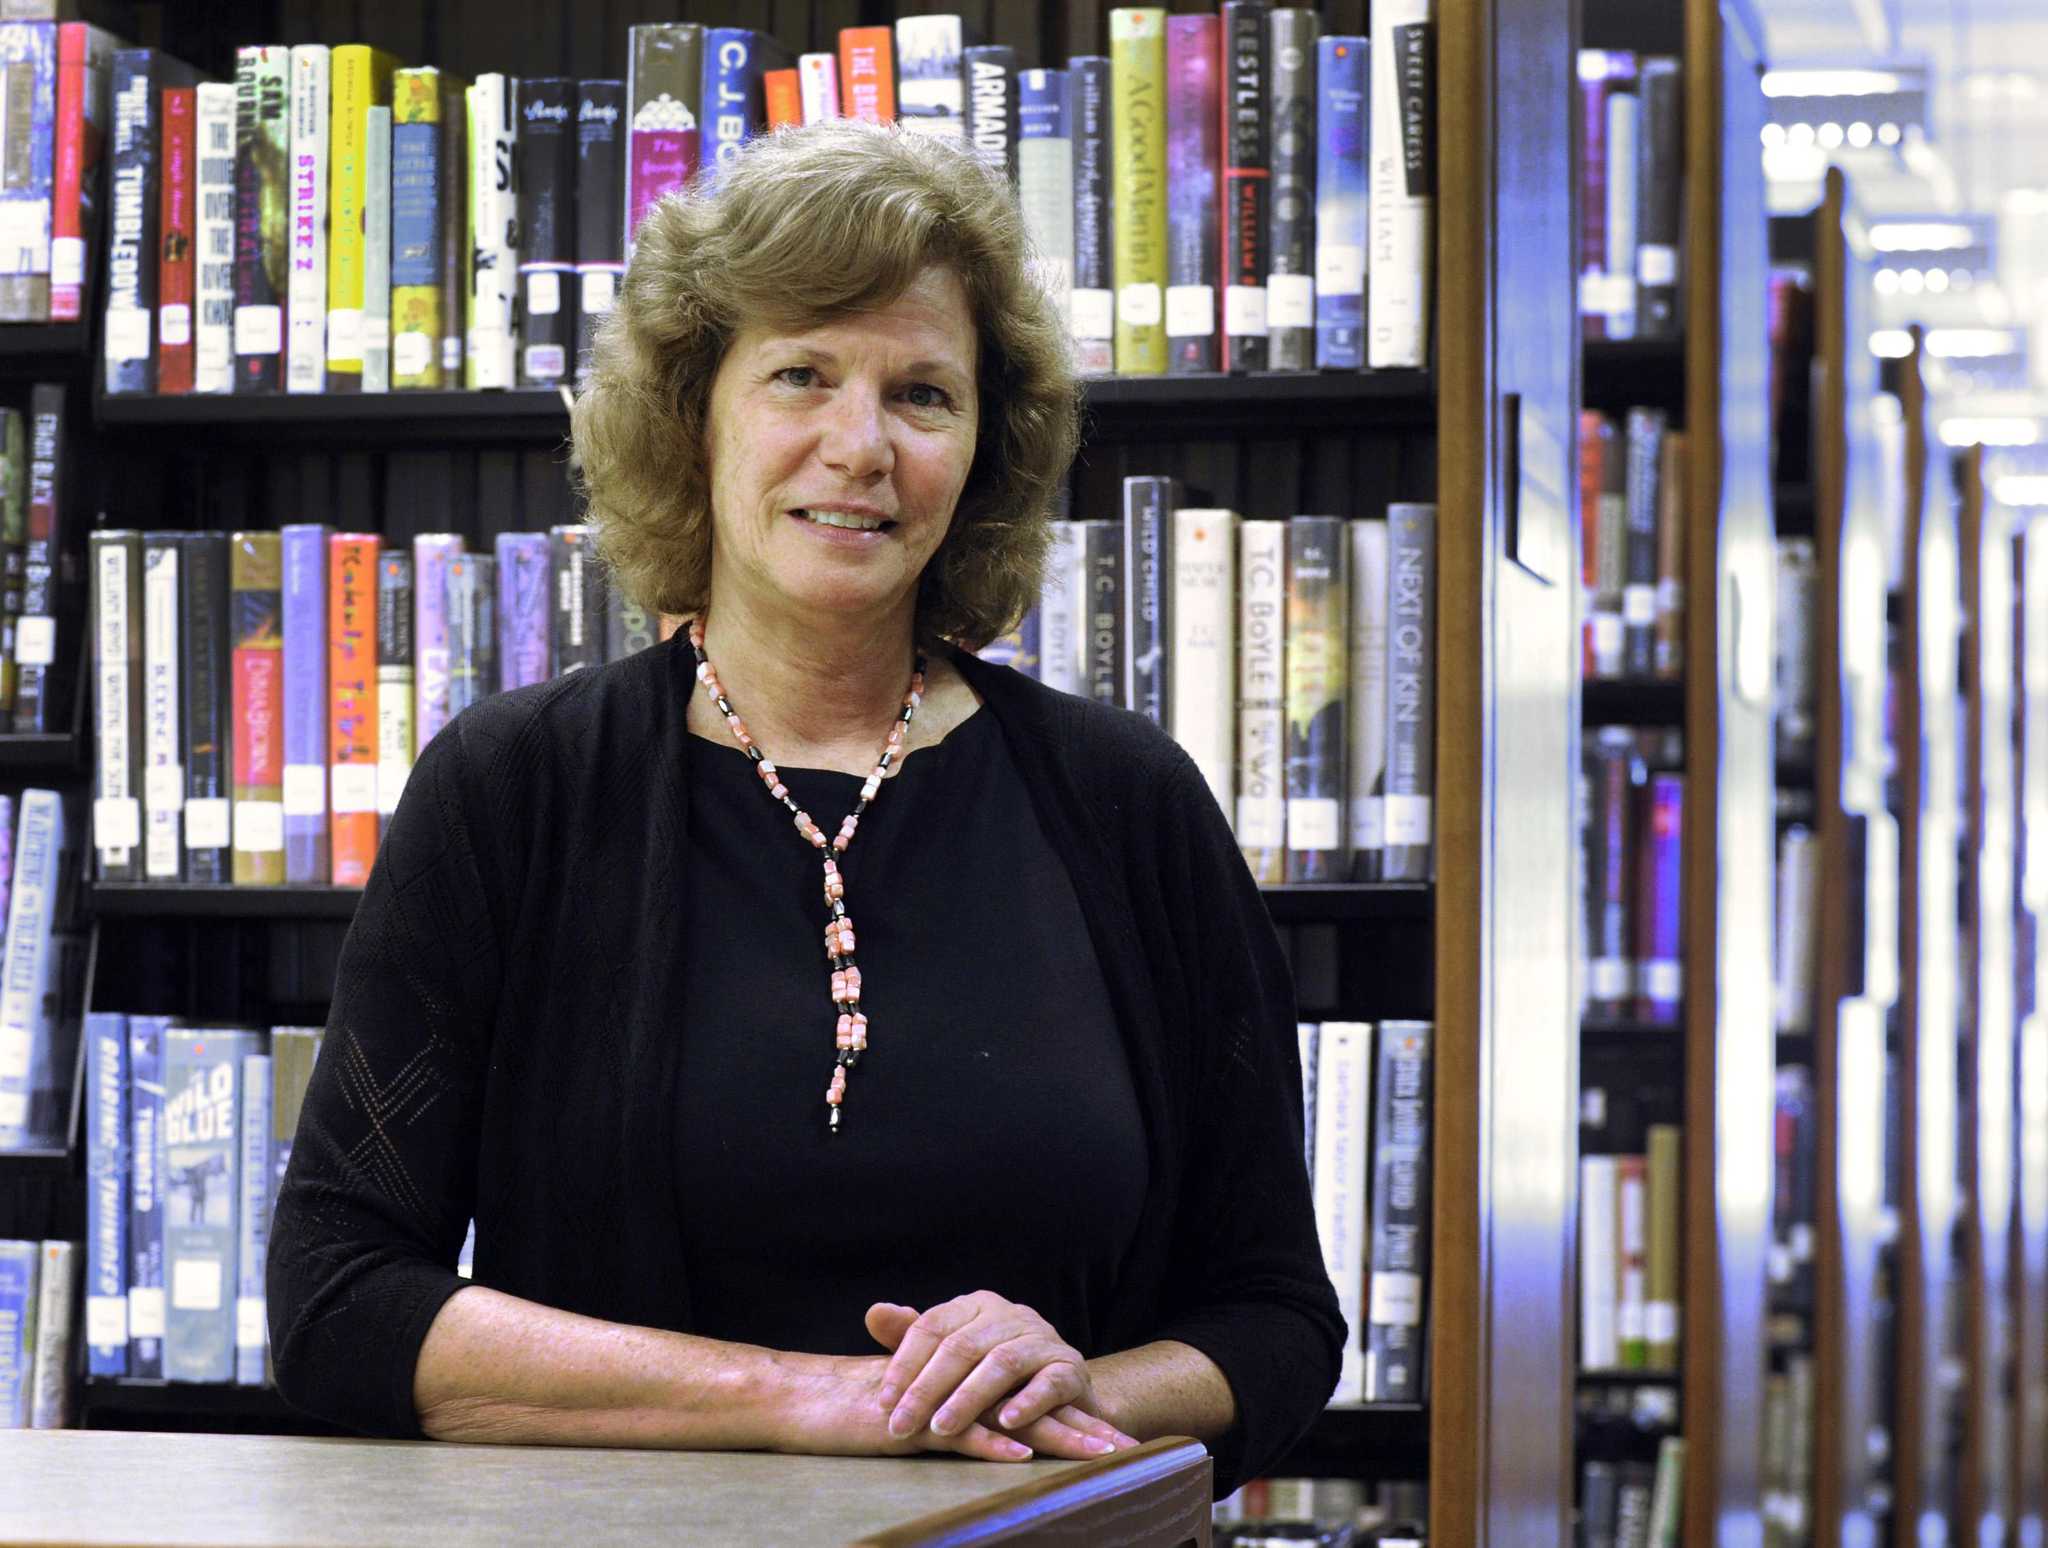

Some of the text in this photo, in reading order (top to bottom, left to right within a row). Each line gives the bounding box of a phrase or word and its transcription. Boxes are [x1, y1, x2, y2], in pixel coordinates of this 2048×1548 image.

[260, 75, 283, 121] SAM
[1237, 17, 1260, 159] RESTLESS
[1405, 28, 1424, 171] SWEET CARESS
[714, 114, 745, 165] BO
[110, 163, 144, 311] TUMBLEDOW
[297, 154, 316, 249] STRIKE
[1240, 183, 1258, 269] WILLIAM
[1396, 546, 1424, 618] NEXT
[1094, 613, 1116, 699] BOYLE
[1396, 624, 1424, 667] OF
[1395, 671, 1423, 722] KIN
[99, 1036, 121, 1295] ROARING THUNDER
[133, 1106, 154, 1212] THUNDER
